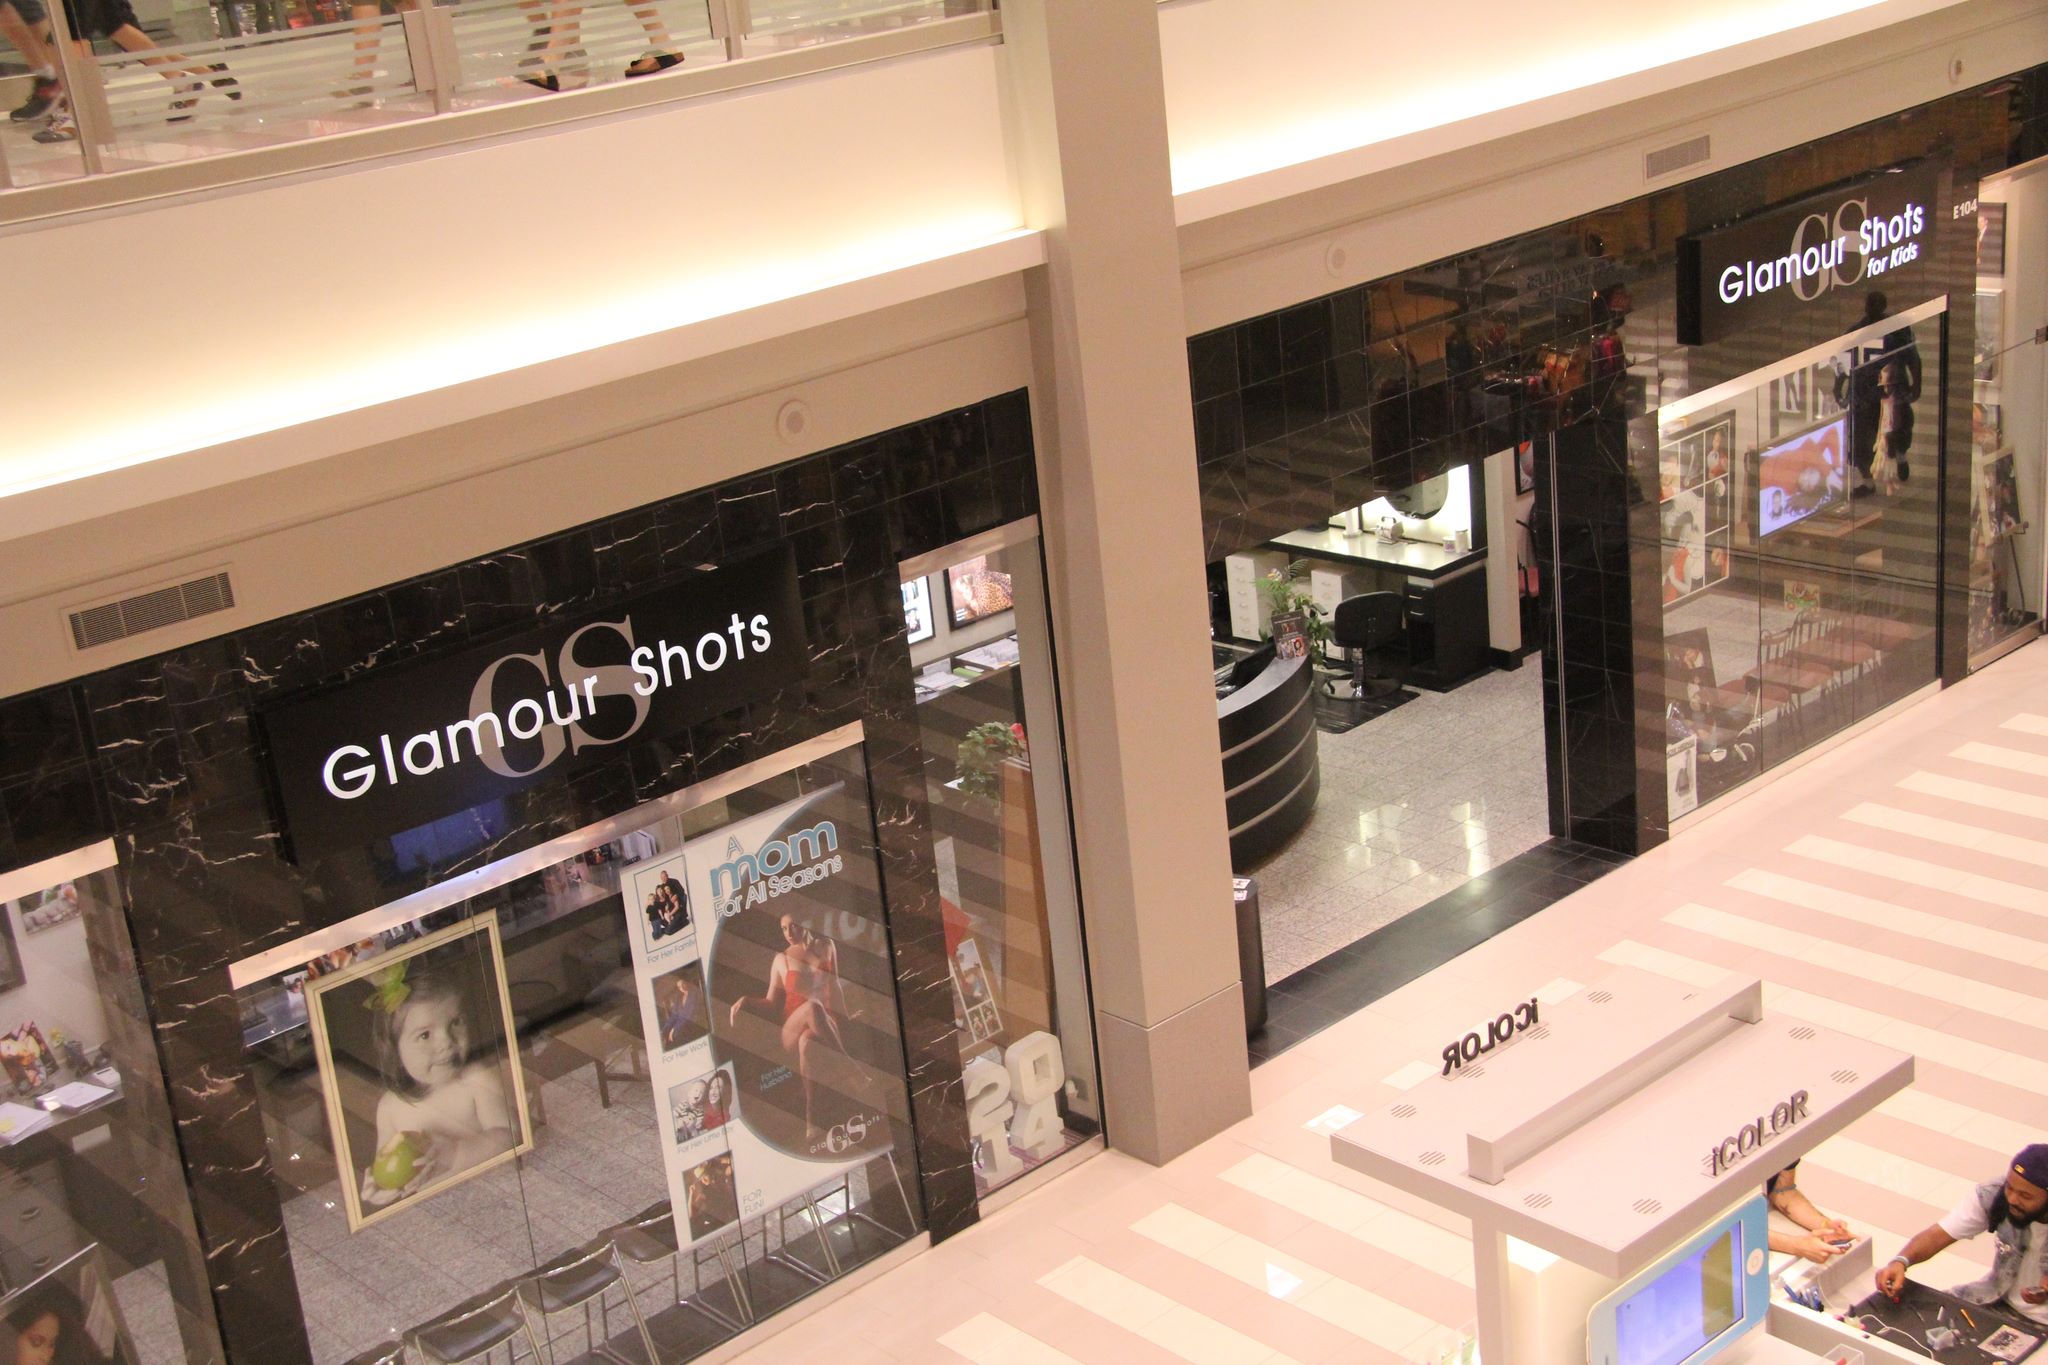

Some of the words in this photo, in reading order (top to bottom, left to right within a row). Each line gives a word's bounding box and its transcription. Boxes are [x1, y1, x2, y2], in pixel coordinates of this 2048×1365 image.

[1719, 235, 1847, 304] Glamour
[1859, 203, 1924, 256] Shots
[1867, 257, 1888, 278] for
[1890, 242, 1917, 269] Kids
[323, 674, 597, 800] Glamour
[630, 613, 772, 697] Shots
[710, 821, 838, 898] mom
[727, 833, 745, 859] A
[713, 894, 743, 921] For
[745, 880, 767, 909] All
[768, 854, 843, 898] Seasons
[1711, 1089, 1809, 1177] iCOLOR
